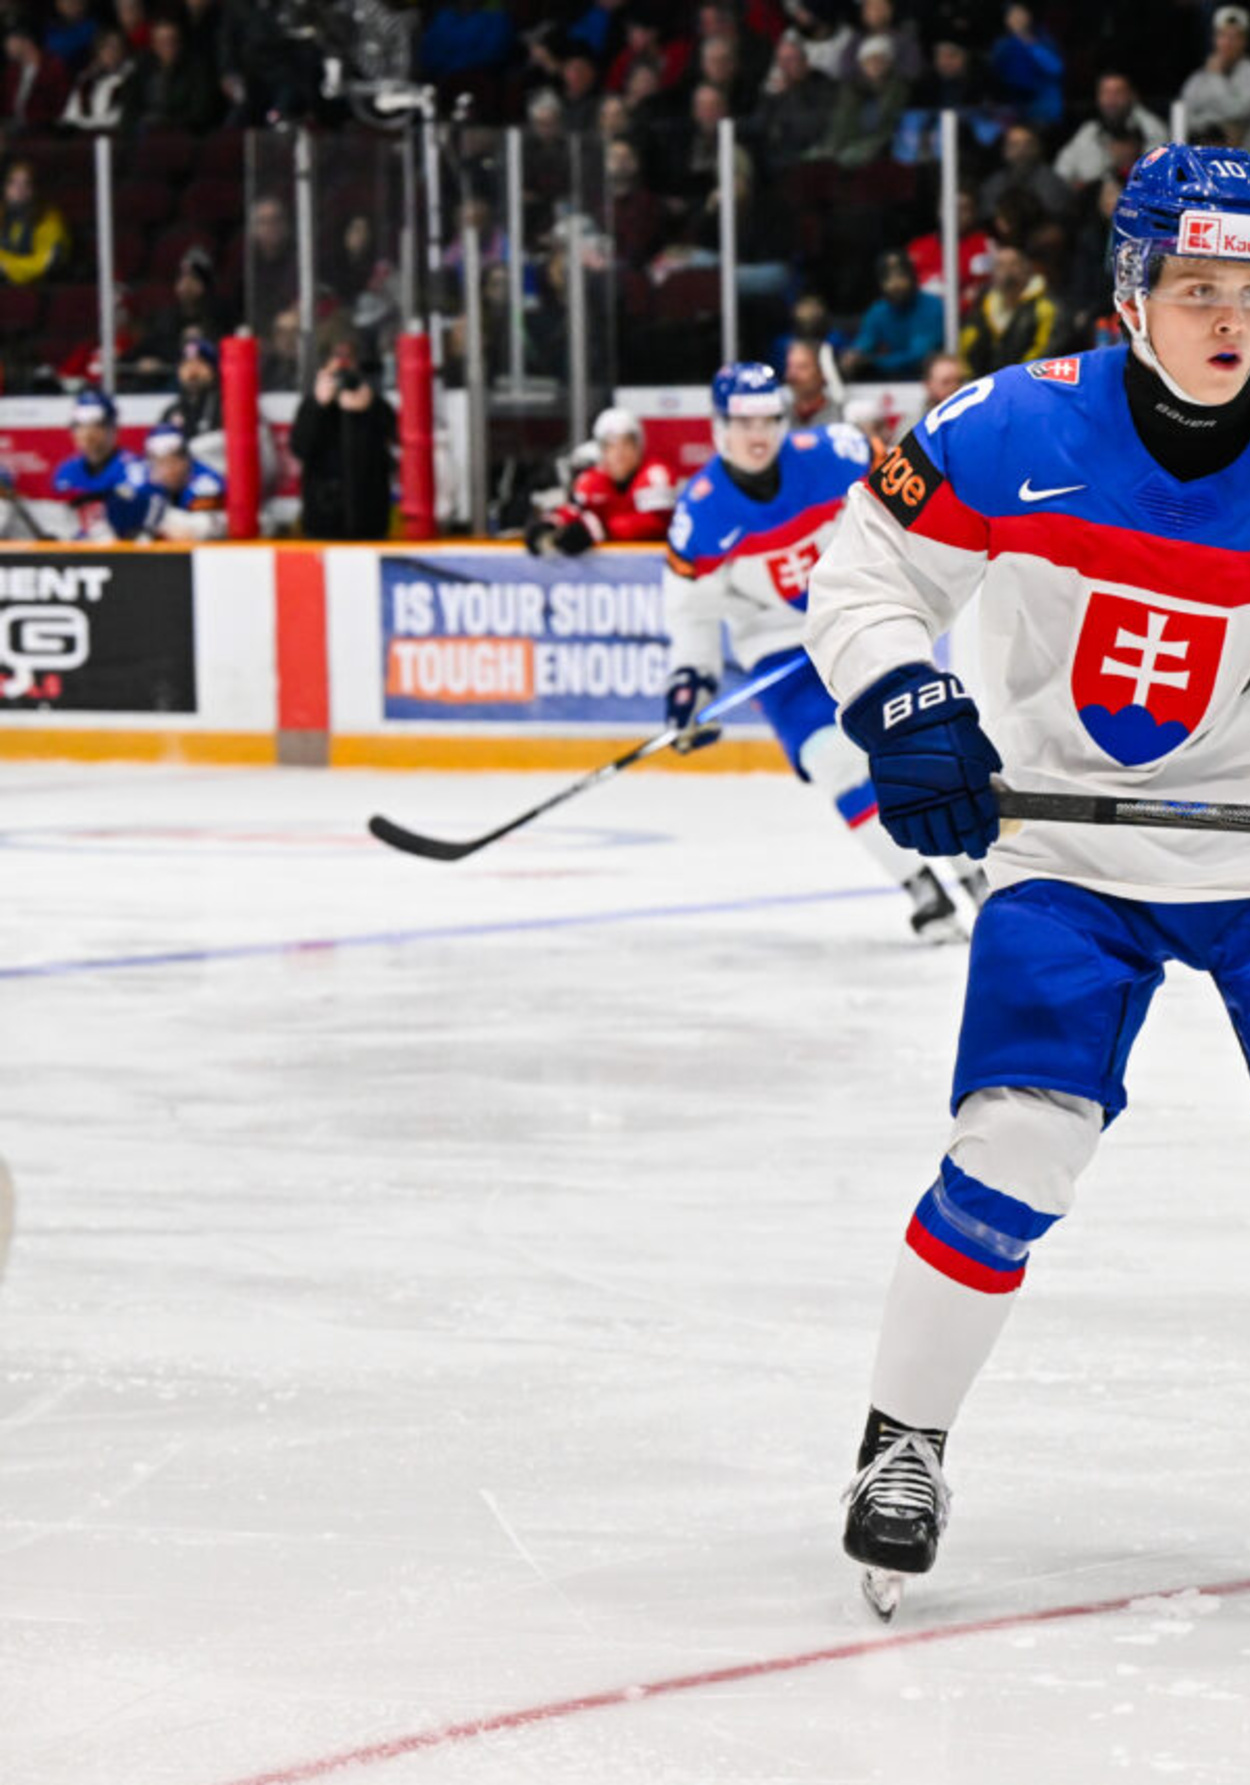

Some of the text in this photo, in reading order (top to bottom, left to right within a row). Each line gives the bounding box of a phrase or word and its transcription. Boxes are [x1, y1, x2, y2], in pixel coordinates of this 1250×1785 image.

[1210, 160, 1247, 179] 10
[0, 566, 112, 601] ENT
[392, 582, 434, 635] IS
[438, 582, 546, 636] YOUR
[393, 641, 527, 695] TOUGH
